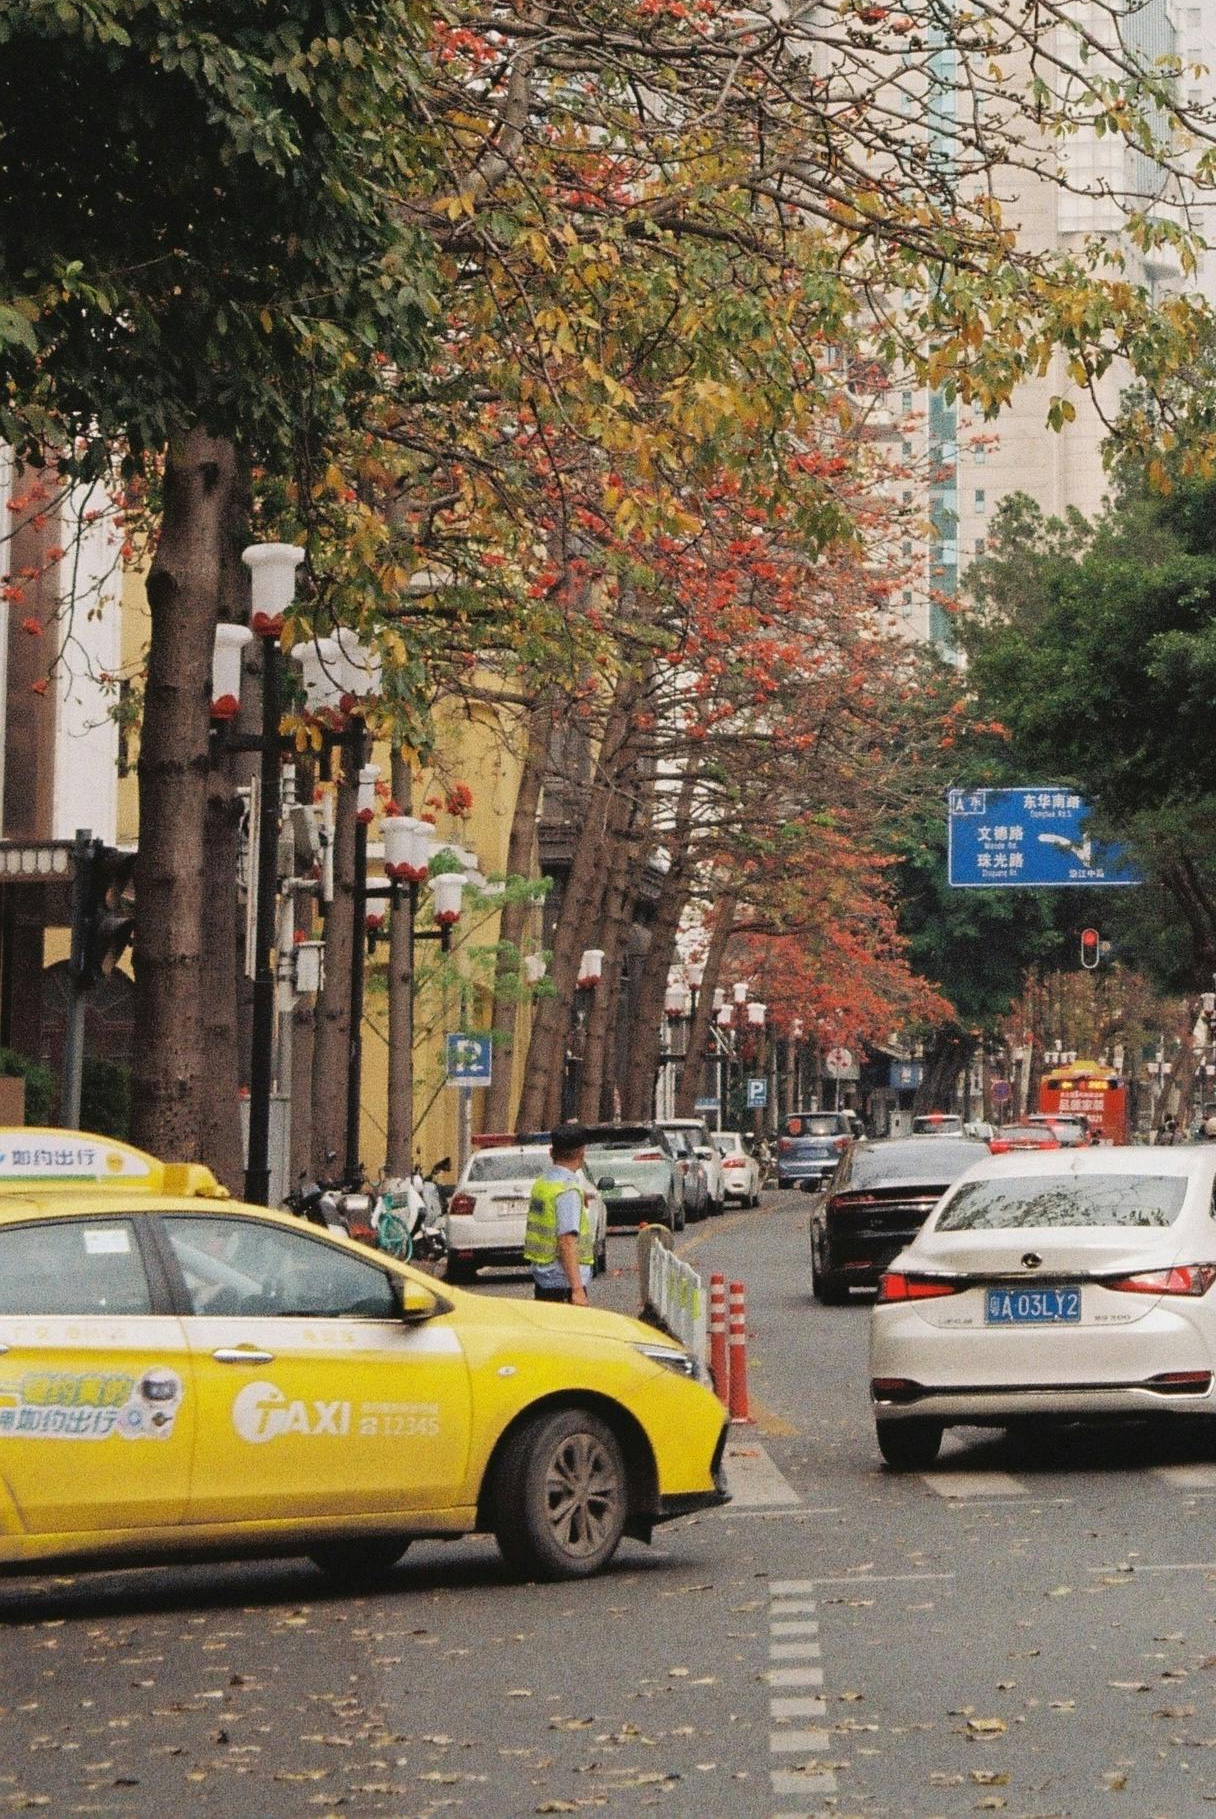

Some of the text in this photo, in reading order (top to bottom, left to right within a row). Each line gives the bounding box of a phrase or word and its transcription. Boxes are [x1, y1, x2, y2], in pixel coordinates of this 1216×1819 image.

[1023, 793, 1080, 809] 东华南路
[977, 825, 1023, 841] 文德路
[977, 852, 1024, 868] 珠光路
[751, 1082, 763, 1099] P
[11, 1149, 97, 1166] 如约出行
[254, 1399, 350, 1435] TAXI
